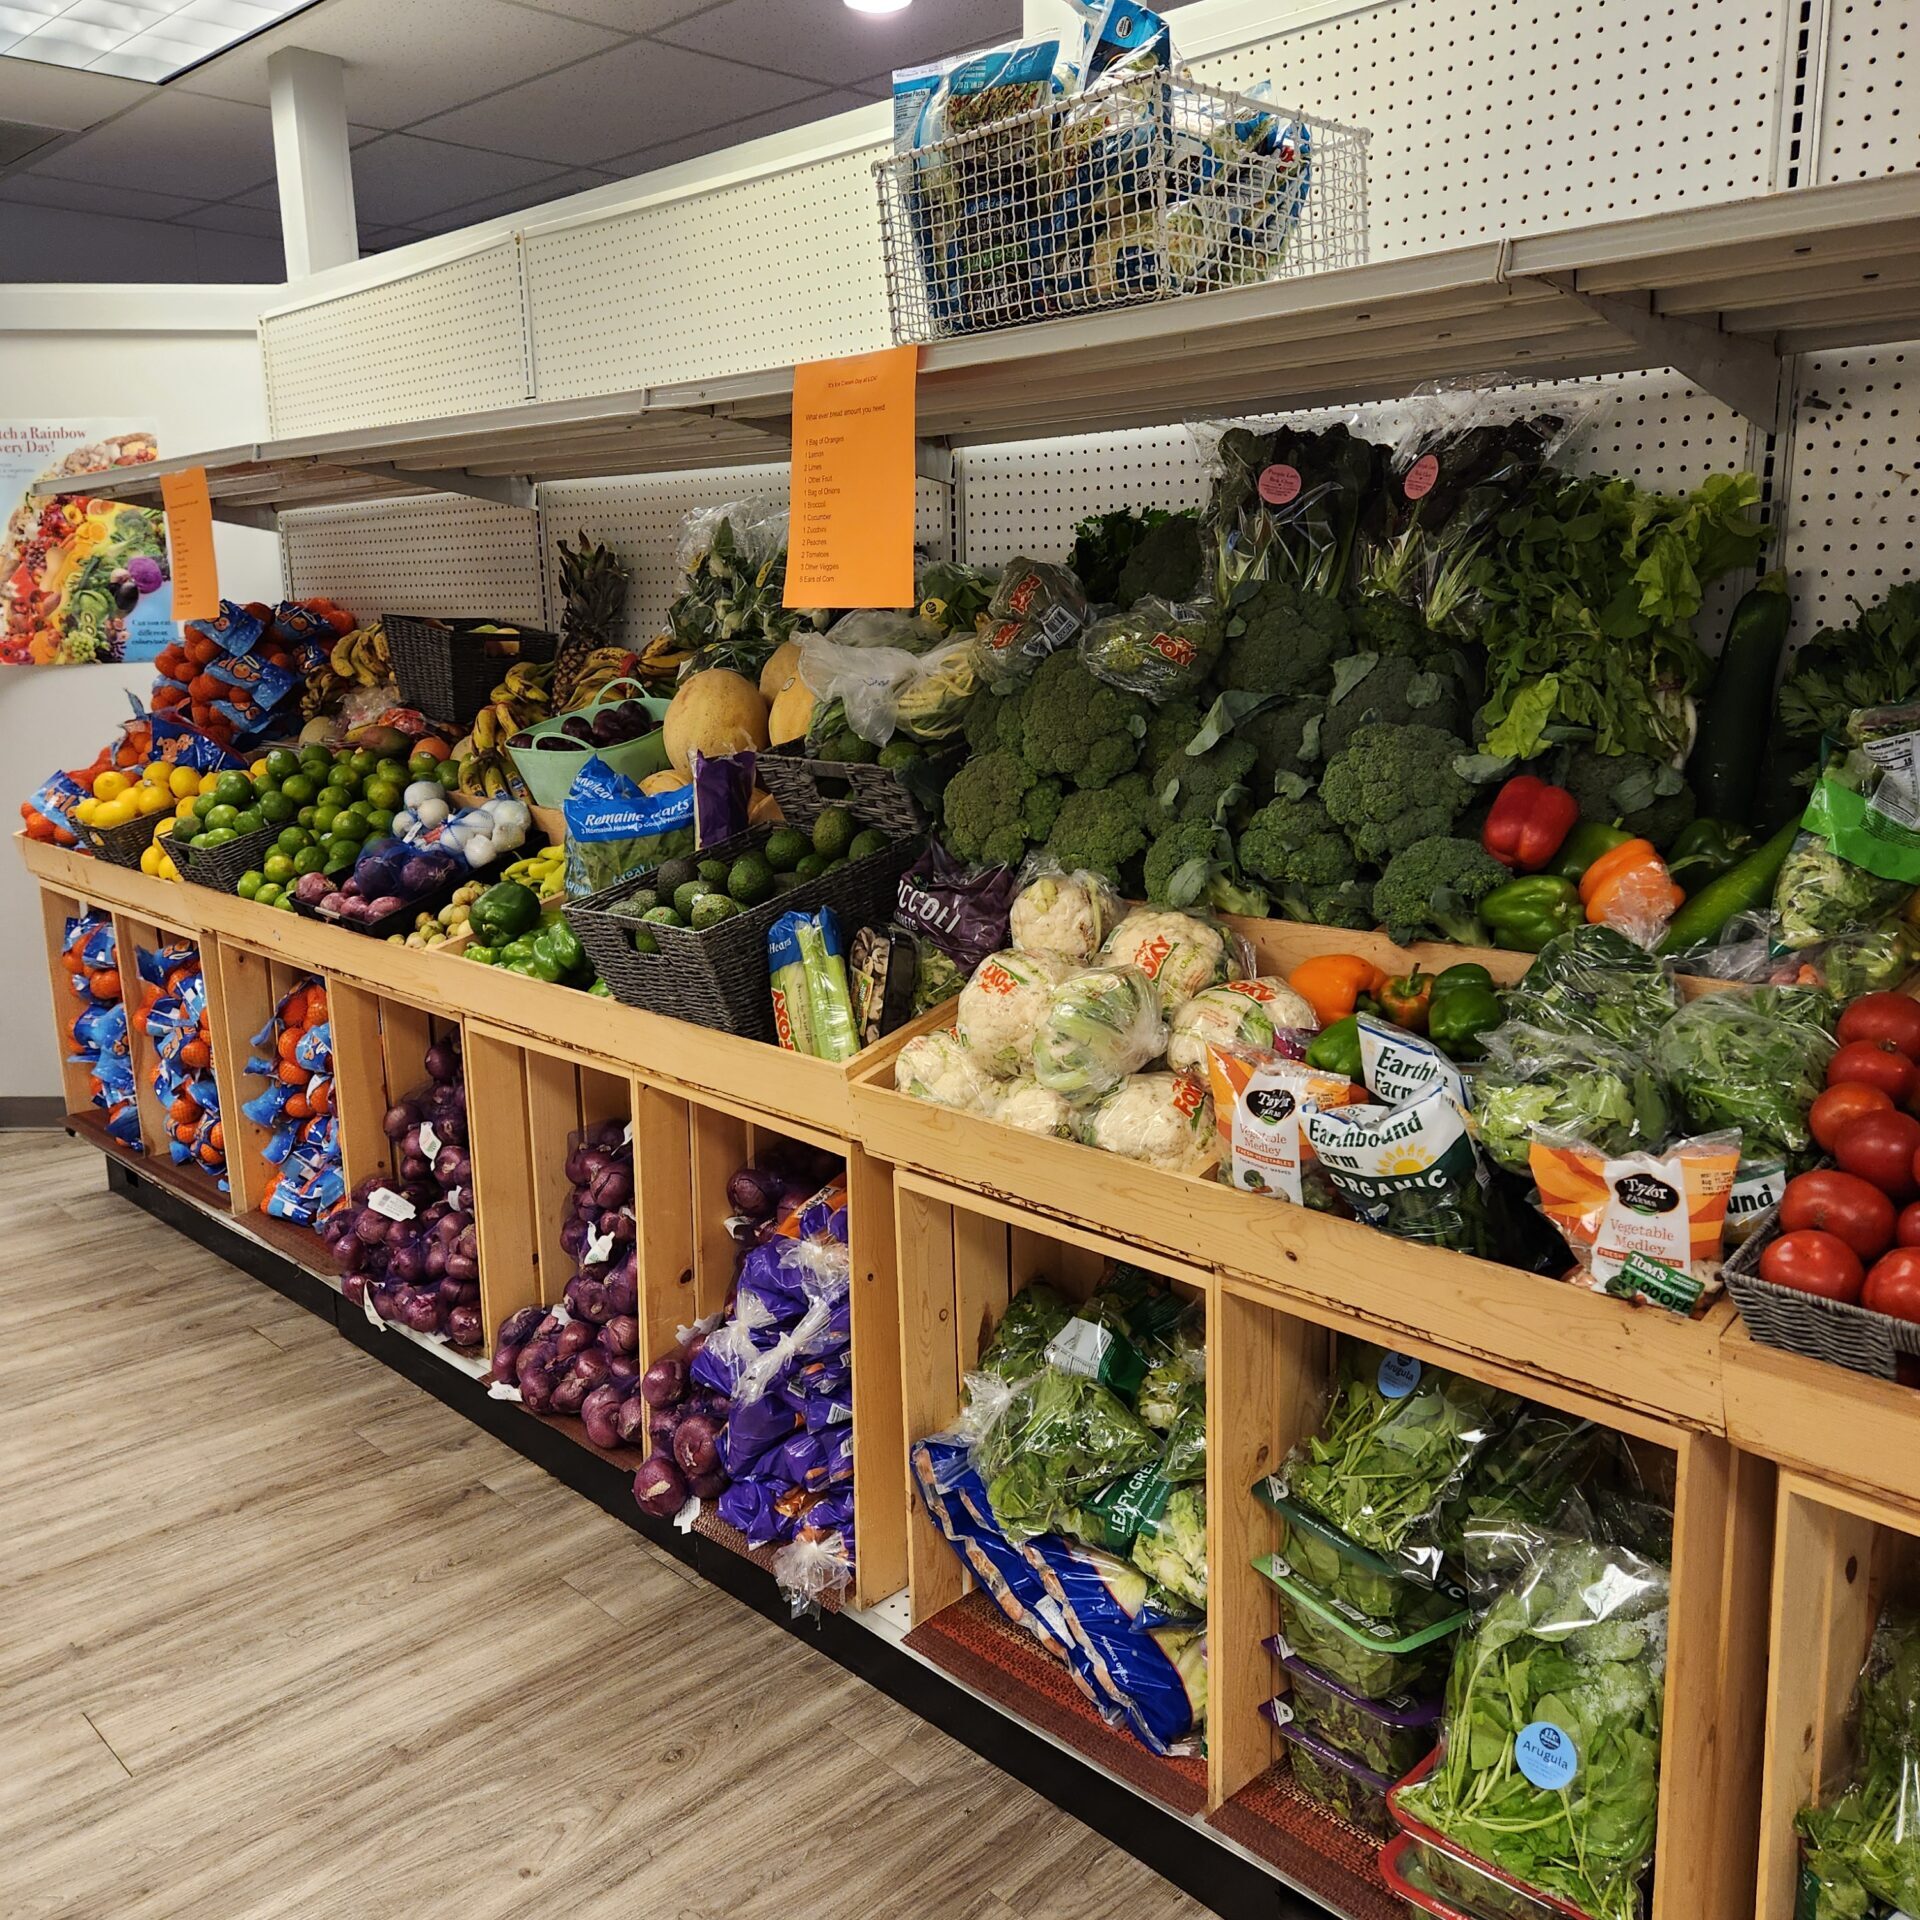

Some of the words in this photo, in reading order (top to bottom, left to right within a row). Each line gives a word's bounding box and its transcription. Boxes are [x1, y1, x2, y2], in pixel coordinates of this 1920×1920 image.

[862, 407, 872, 415] you
[20, 430, 28, 440] a
[30, 427, 87, 440] Rainbow
[824, 436, 845, 445] Oranges
[27, 440, 56, 457] Day!
[808, 489, 817, 497] Bag
[823, 487, 841, 495] Onions
[806, 538, 827, 546] Peaches
[806, 551, 829, 559] Tomatoes
[1149, 632, 1198, 669] FOXY
[217, 656, 261, 682] alos
[1894, 737, 1911, 746] Facts
[585, 811, 645, 826] Romaine
[897, 879, 961, 934] CCOLI
[1308, 1110, 1424, 1149] Earthbound
[1244, 1137, 1282, 1156] Medley
[1317, 1150, 1361, 1169] arm
[1329, 1168, 1447, 1198] ORGANIC
[1610, 1218, 1674, 1241] Vegetable
[1615, 1234, 1667, 1256] Medley
[1384, 1360, 1414, 1382] Arugula
[1111, 1489, 1137, 1534] LEAFY
[1128, 1460, 1160, 1490] GREE
[1146, 1499, 1158, 1519] xcellent
[1100, 1635, 1119, 1662] PRODUCE
[1305, 1669, 1322, 1682] Farmer
[1326, 1682, 1341, 1693] Family
[1301, 1736, 1318, 1750] Farmer
[1322, 1749, 1337, 1761] Family
[1522, 1740, 1569, 1771] Arugula
